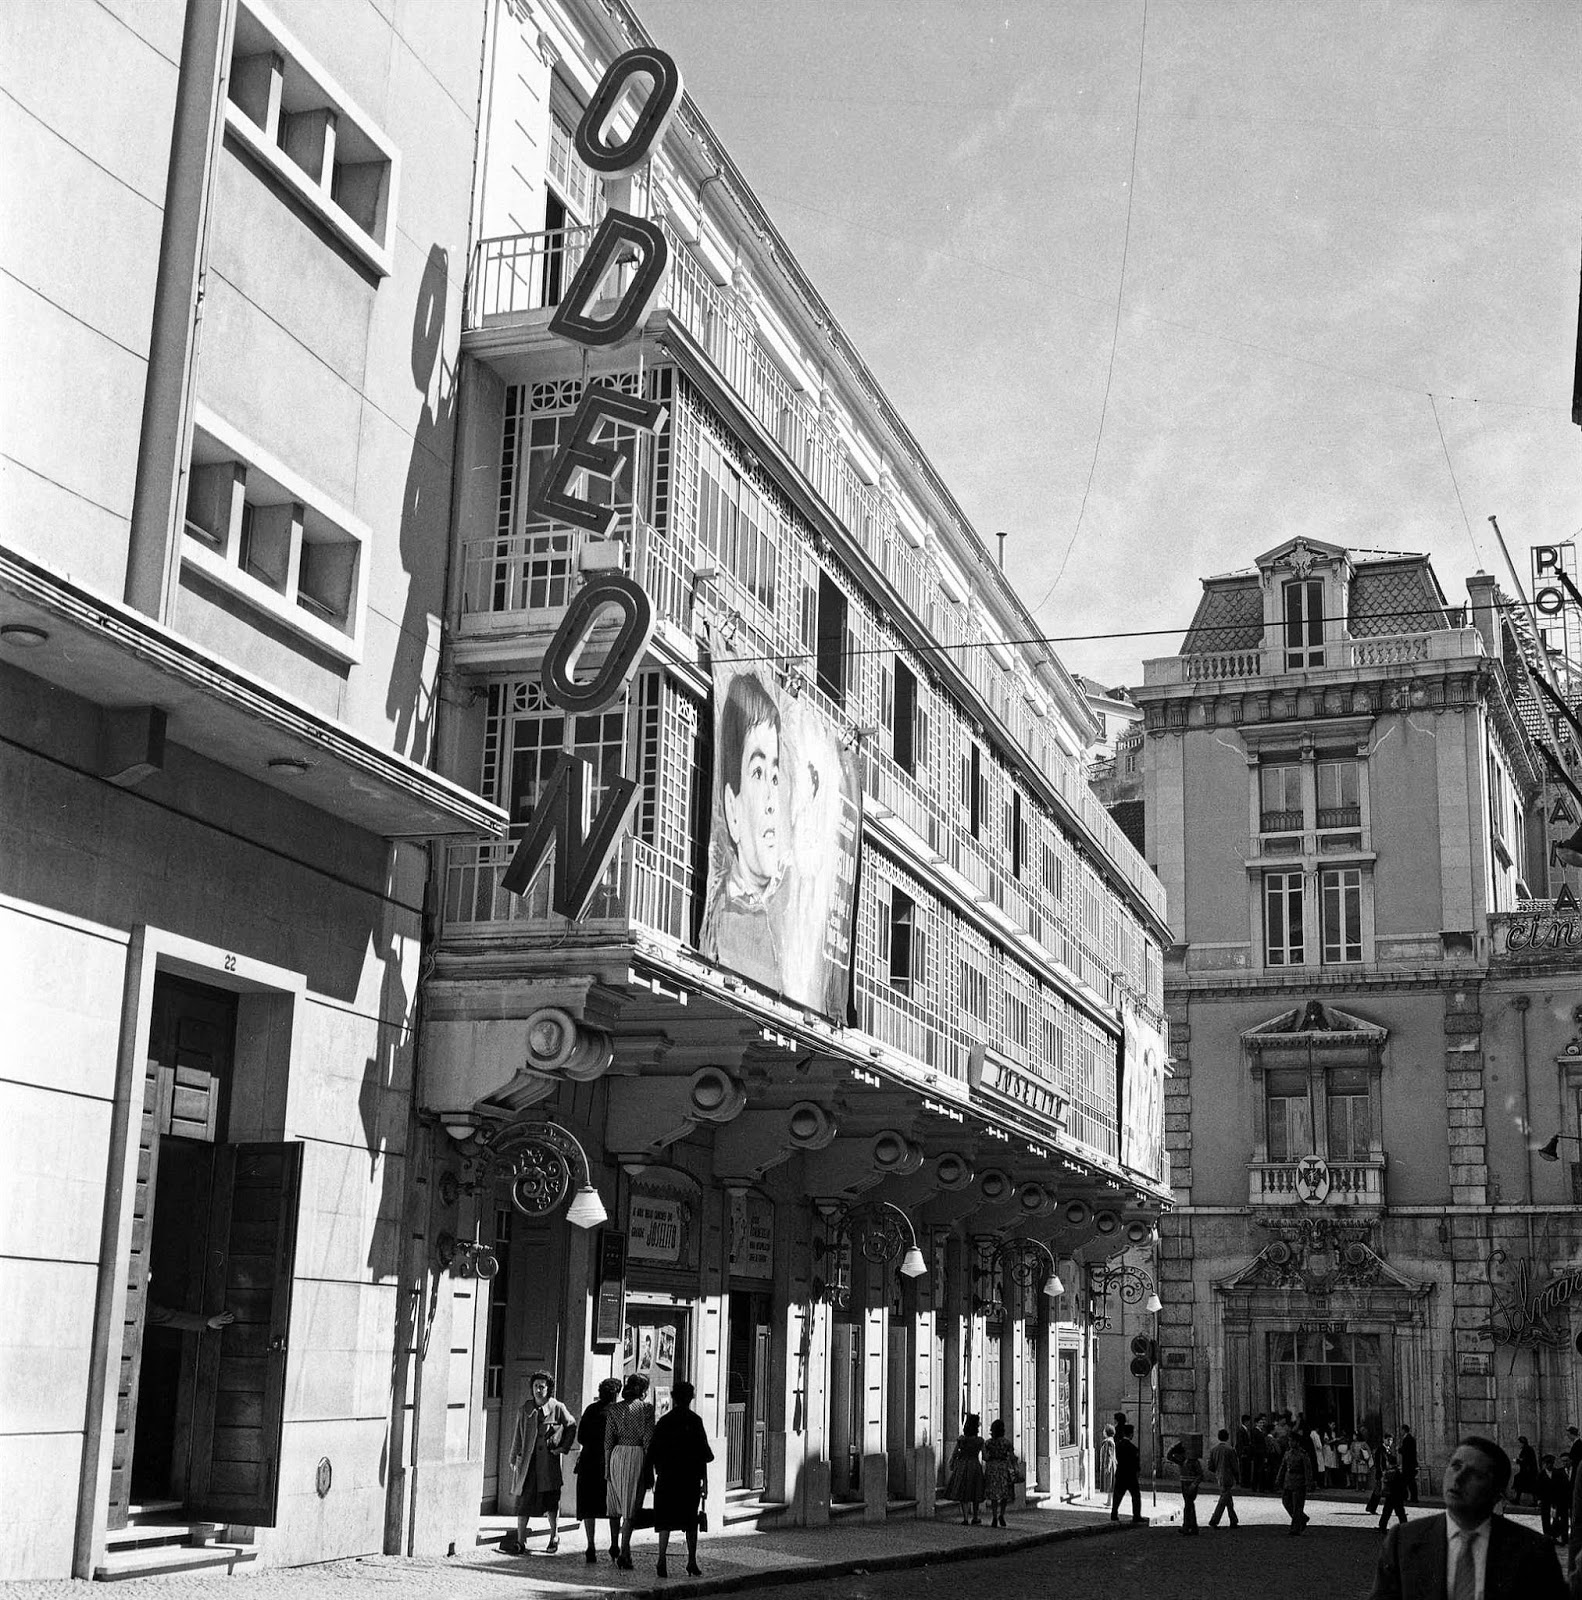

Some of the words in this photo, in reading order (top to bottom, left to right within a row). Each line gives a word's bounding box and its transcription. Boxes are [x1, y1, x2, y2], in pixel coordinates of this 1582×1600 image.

[501, 46, 682, 924] ODEON
[1536, 545, 1580, 911] POLTAA
[225, 954, 237, 971] 22
[995, 1065, 1062, 1119] JOSELITO
[646, 1221, 677, 1249] JOSELITO
